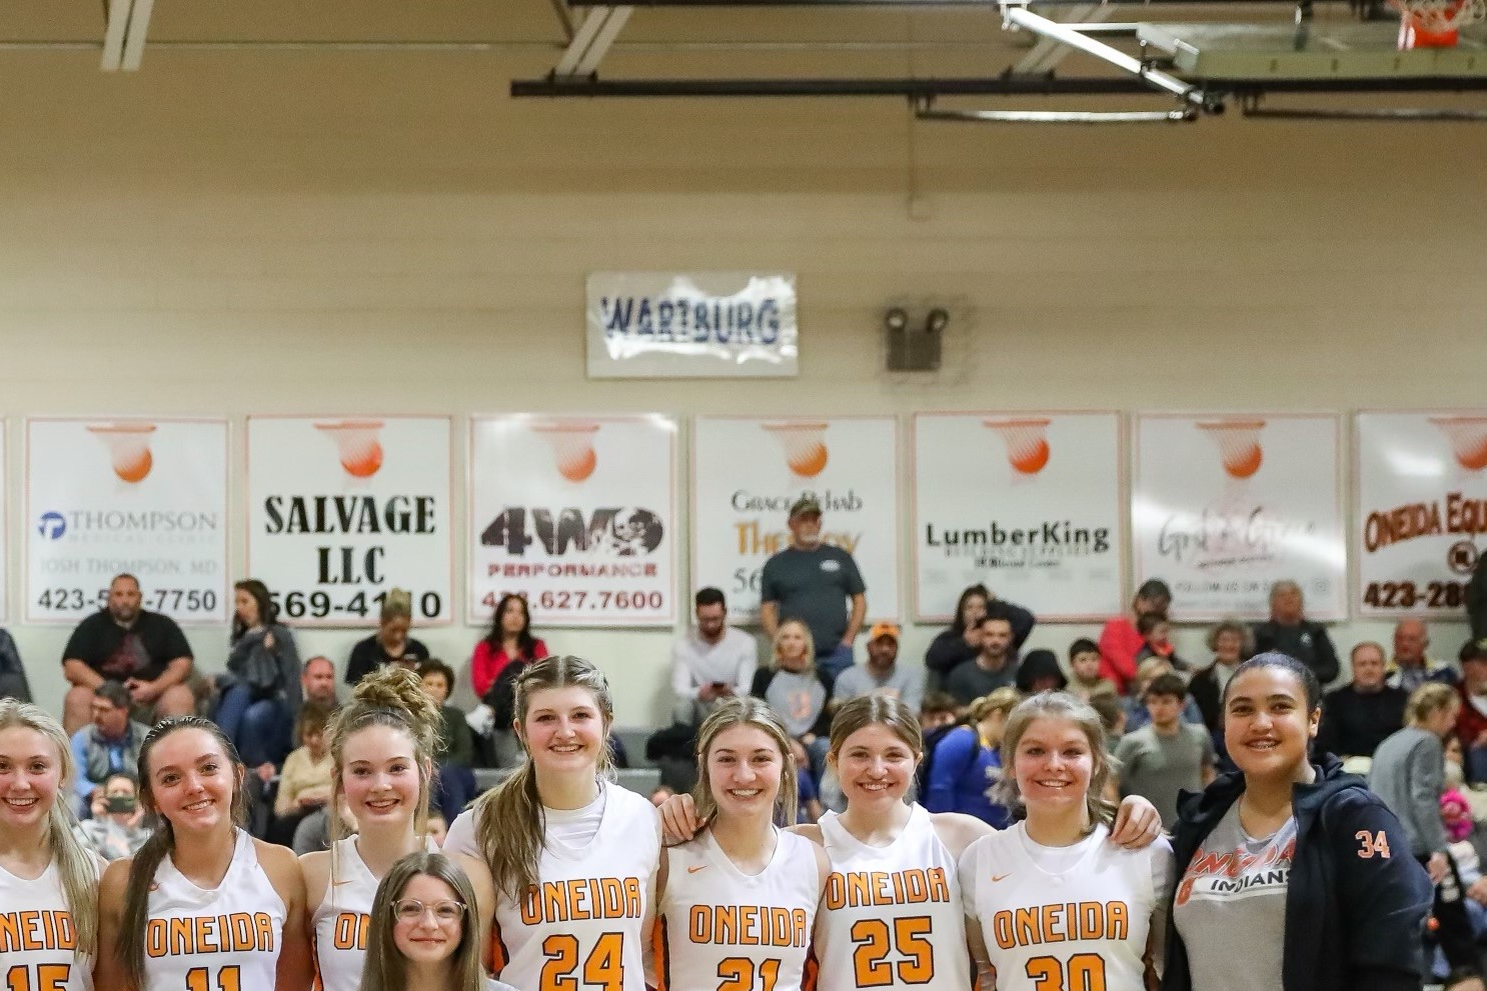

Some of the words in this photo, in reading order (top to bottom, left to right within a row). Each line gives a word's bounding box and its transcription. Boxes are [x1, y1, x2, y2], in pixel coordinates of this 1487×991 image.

[600, 296, 780, 344] WARTBURG
[68, 510, 218, 532] THOMPSON
[264, 494, 436, 535] SALVAGE
[925, 519, 1110, 553] LumberKing
[191, 558, 218, 576] MD
[317, 545, 386, 585] LLC
[487, 563, 658, 578] PERFORMANCE
[38, 588, 218, 612] 423-5-7750
[1355, 830, 1391, 858] 34
[520, 876, 641, 926] ONEIDA
[825, 866, 951, 911] ONEIDA
[146, 911, 274, 958] ONEIDA
[688, 904, 807, 948] ONEIDA
[993, 900, 1129, 950] ONEIDA
[850, 915, 935, 989] 25
